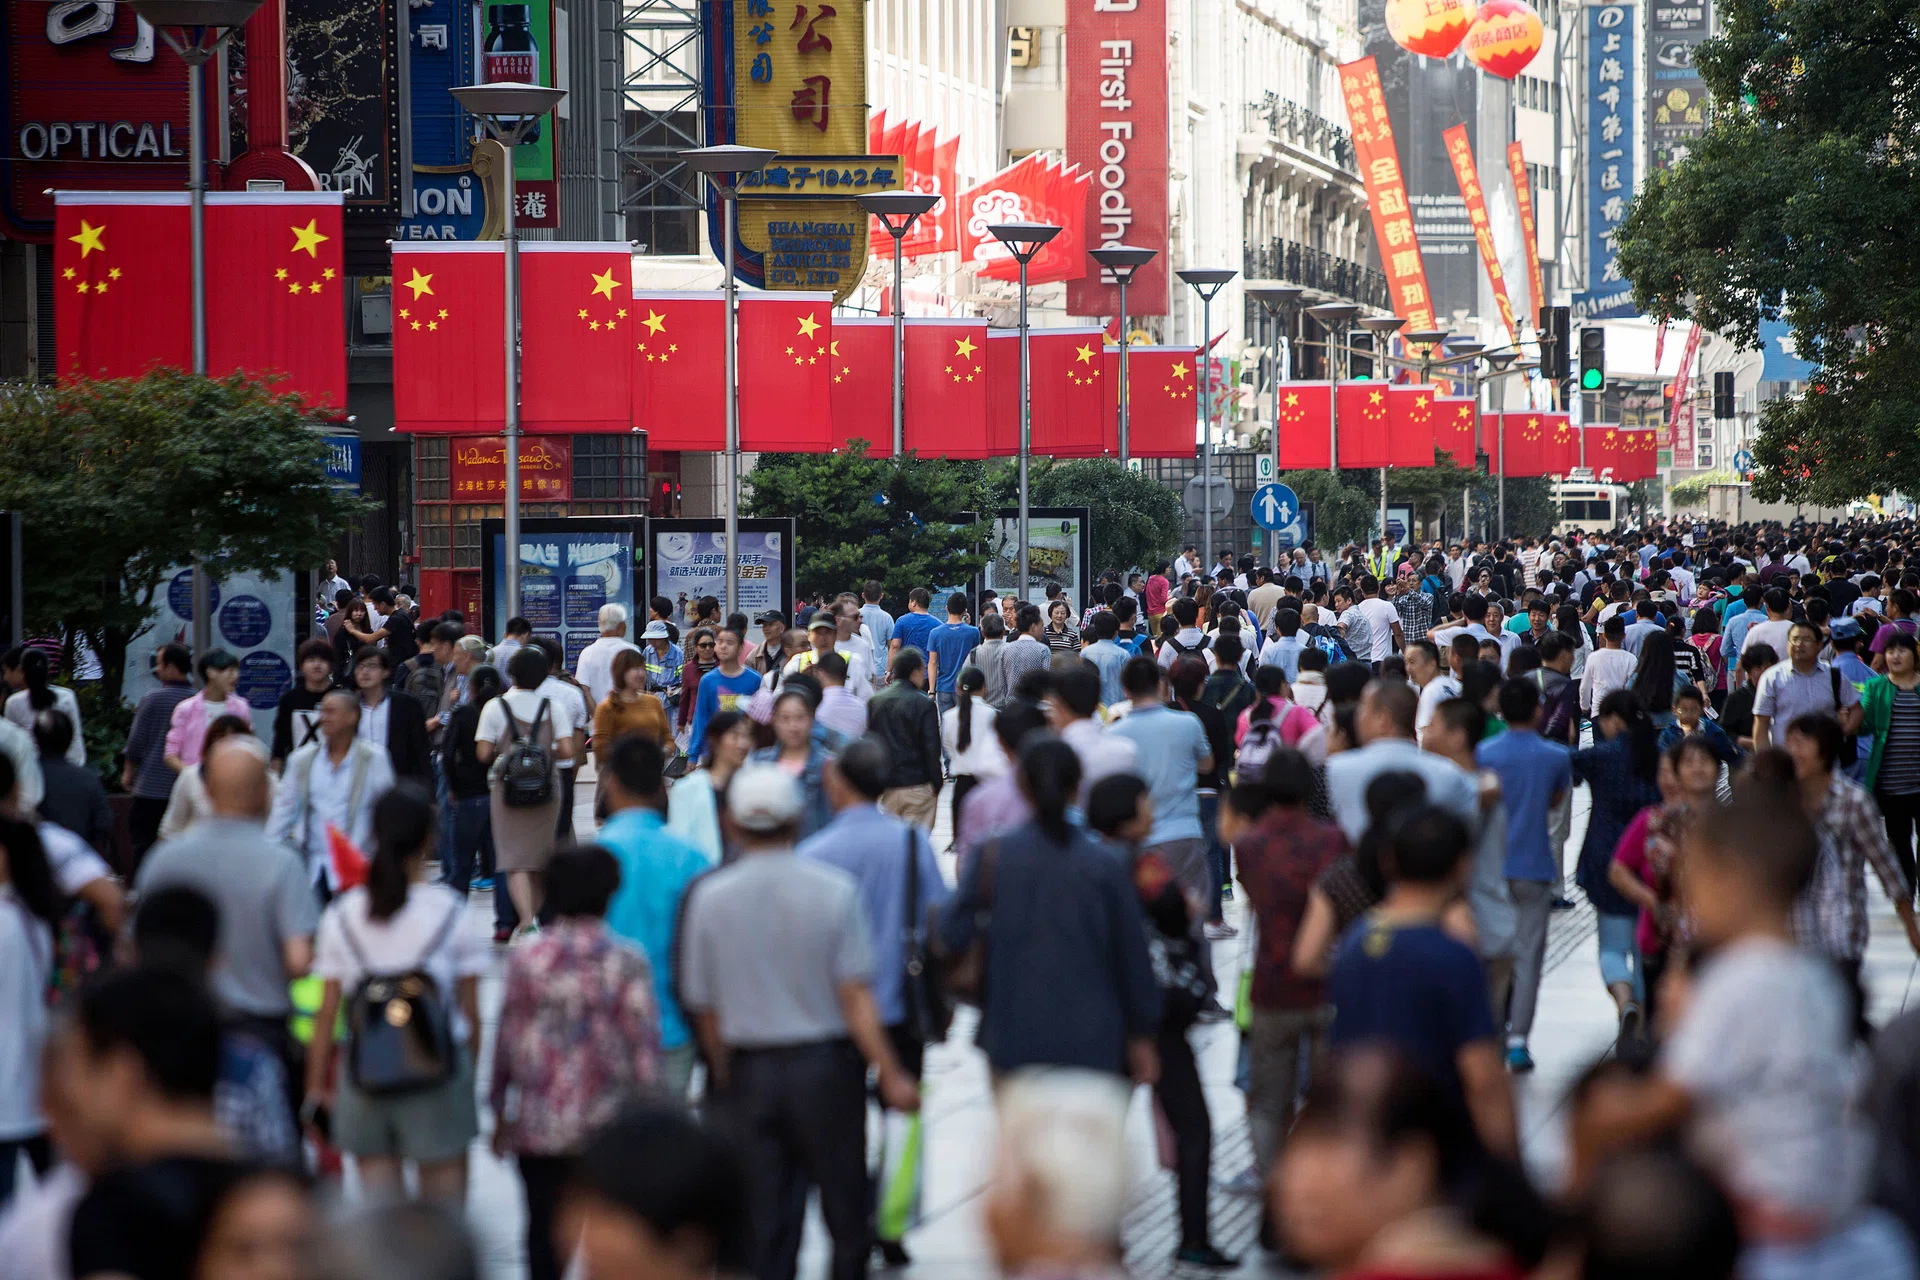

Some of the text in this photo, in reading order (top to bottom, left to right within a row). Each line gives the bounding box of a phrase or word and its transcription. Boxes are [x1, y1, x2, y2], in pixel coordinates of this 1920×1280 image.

[788, 4, 837, 133] 公司
[1100, 40, 1132, 111] First
[20, 122, 184, 159] OPTICAL
[767, 221, 855, 236] SHANGHAI
[771, 238, 852, 252] BEDROOM
[771, 253, 851, 269] ARTICLES
[457, 445, 554, 471] Madame Tsauds
[456, 480, 562, 491] 上海杜莎夫蜡像馆
